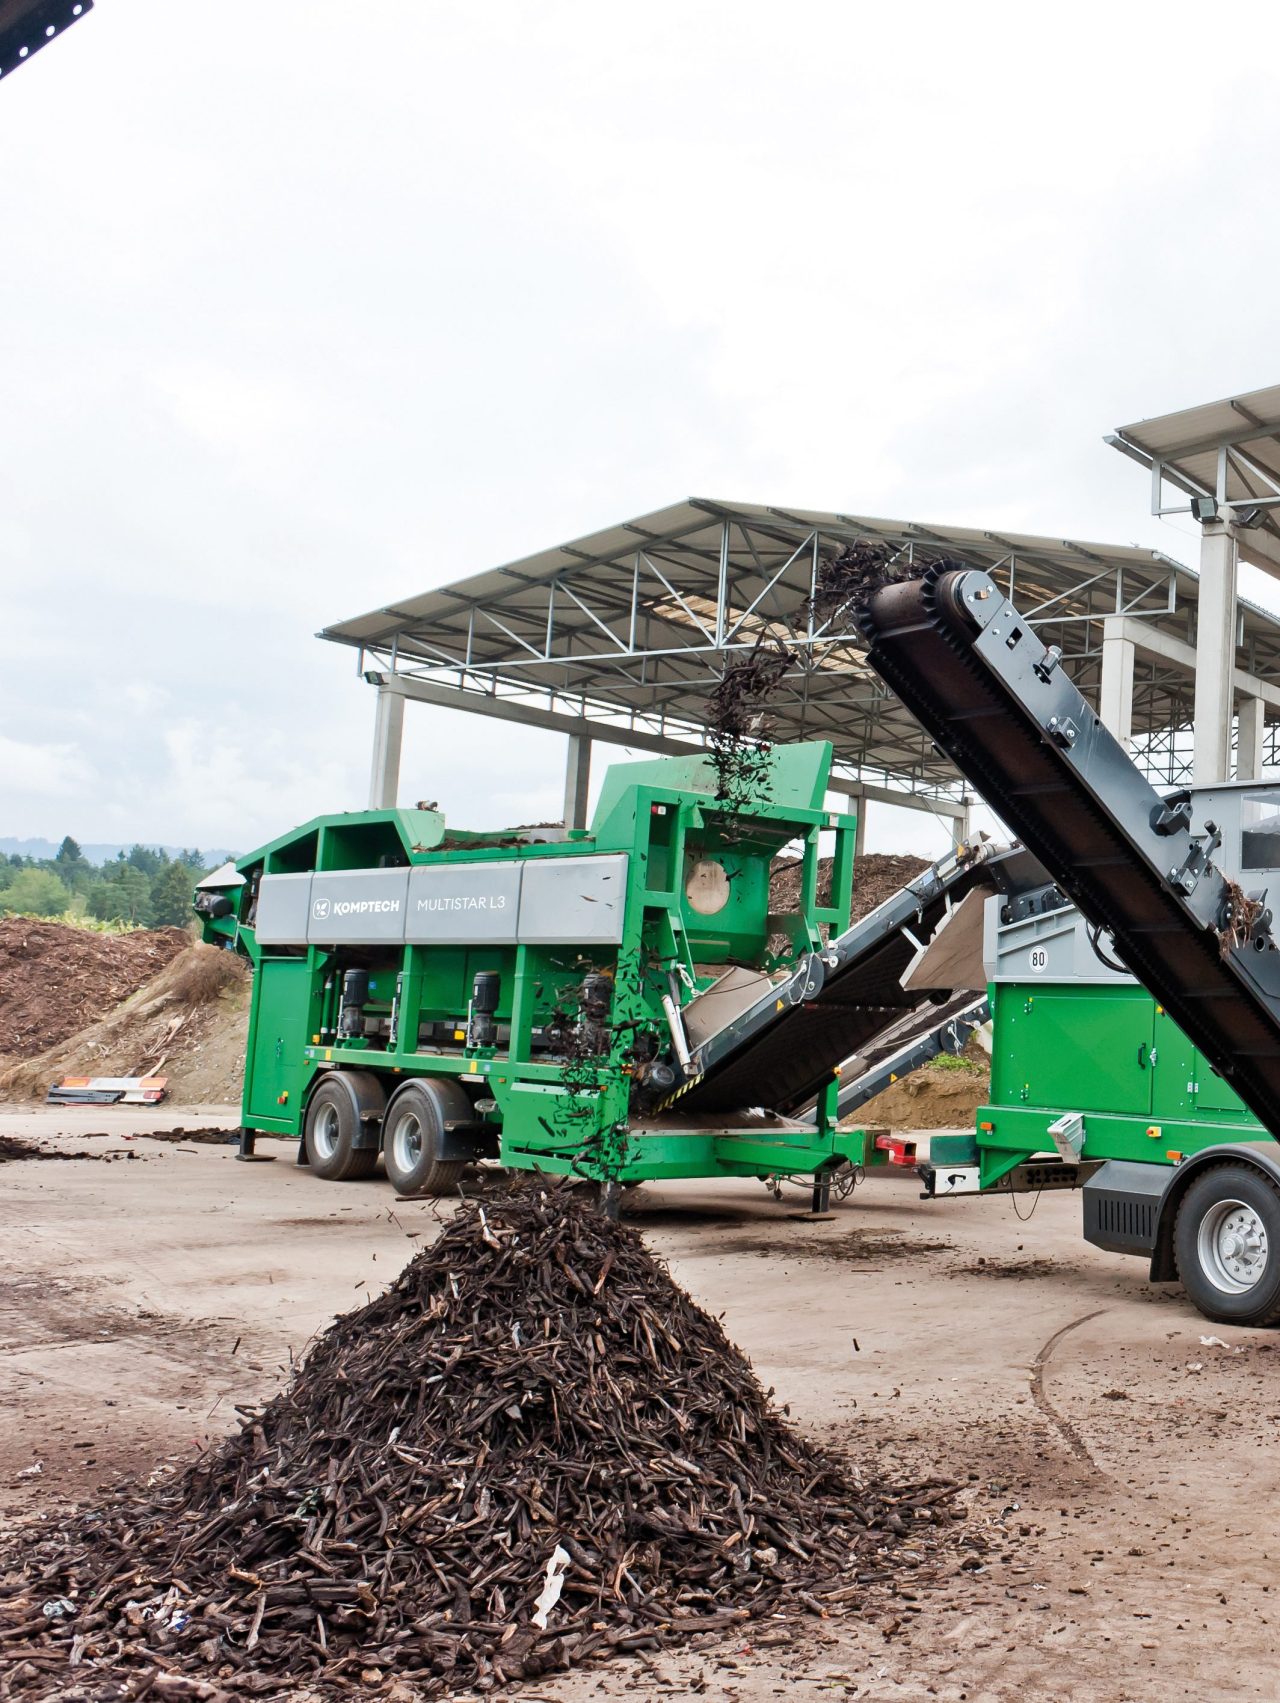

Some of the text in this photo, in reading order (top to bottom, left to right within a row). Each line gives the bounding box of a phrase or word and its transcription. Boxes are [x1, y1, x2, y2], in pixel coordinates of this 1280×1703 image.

[333, 895, 506, 916] KOMPTECH MULTISTAR L3
[1032, 952, 1045, 966] 80
